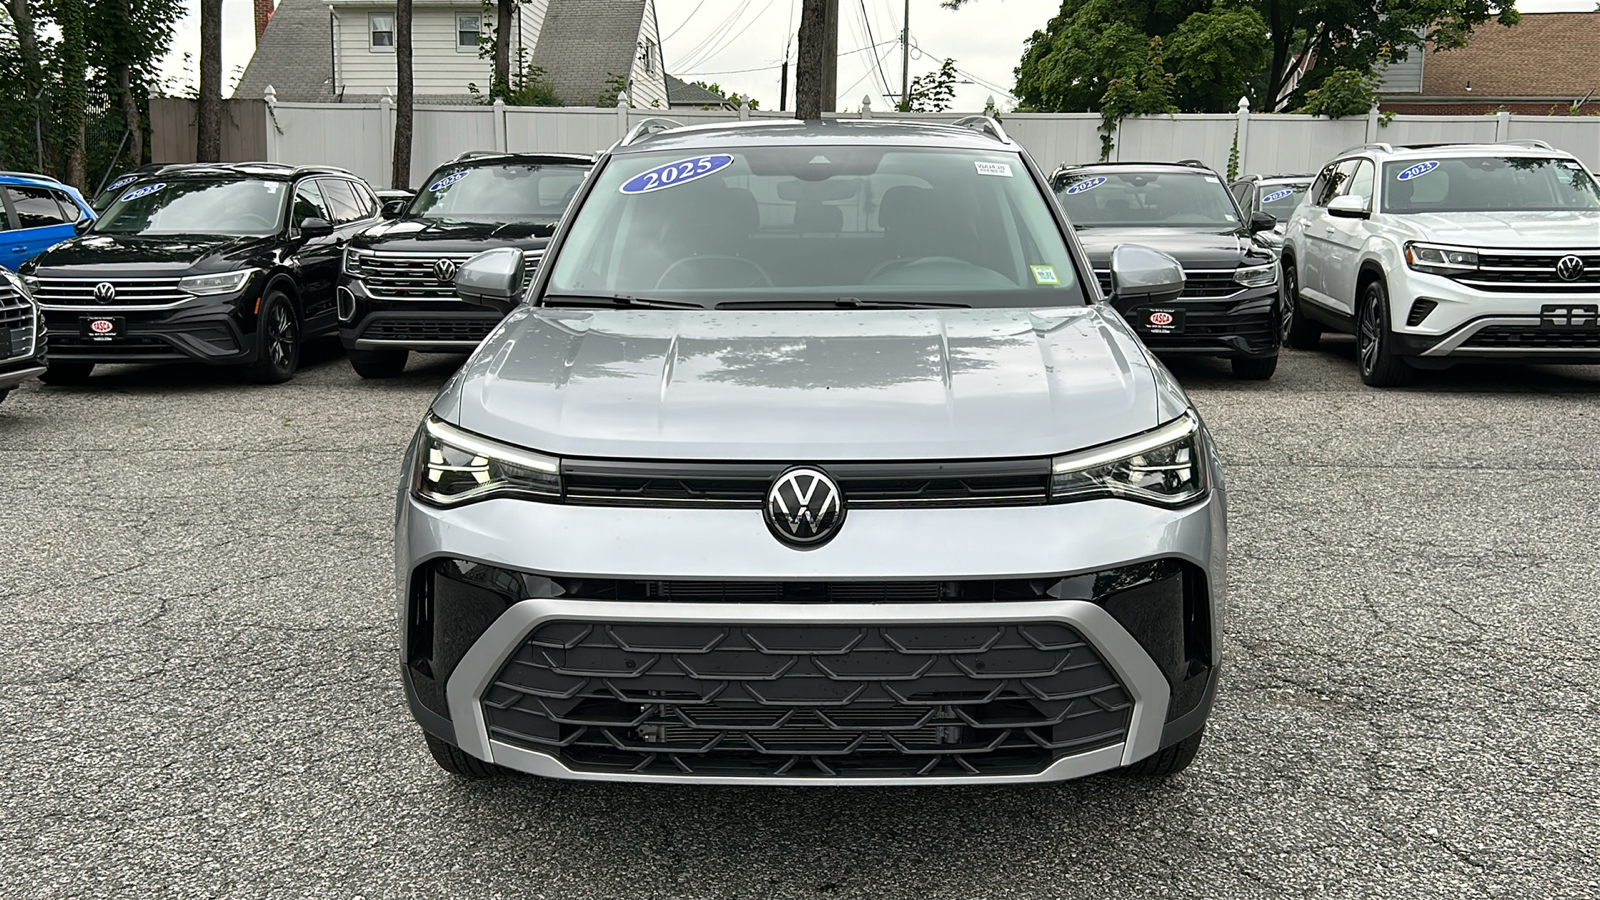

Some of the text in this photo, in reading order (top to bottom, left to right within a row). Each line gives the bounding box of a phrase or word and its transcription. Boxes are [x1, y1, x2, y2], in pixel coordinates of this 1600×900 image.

[642, 156, 712, 191] 2025
[1404, 162, 1433, 179] 2023
[1074, 178, 1100, 193] 2024
[94, 321, 111, 331] TASCA
[1152, 313, 1171, 323] TASCA
[769, 469, 840, 541] VW
